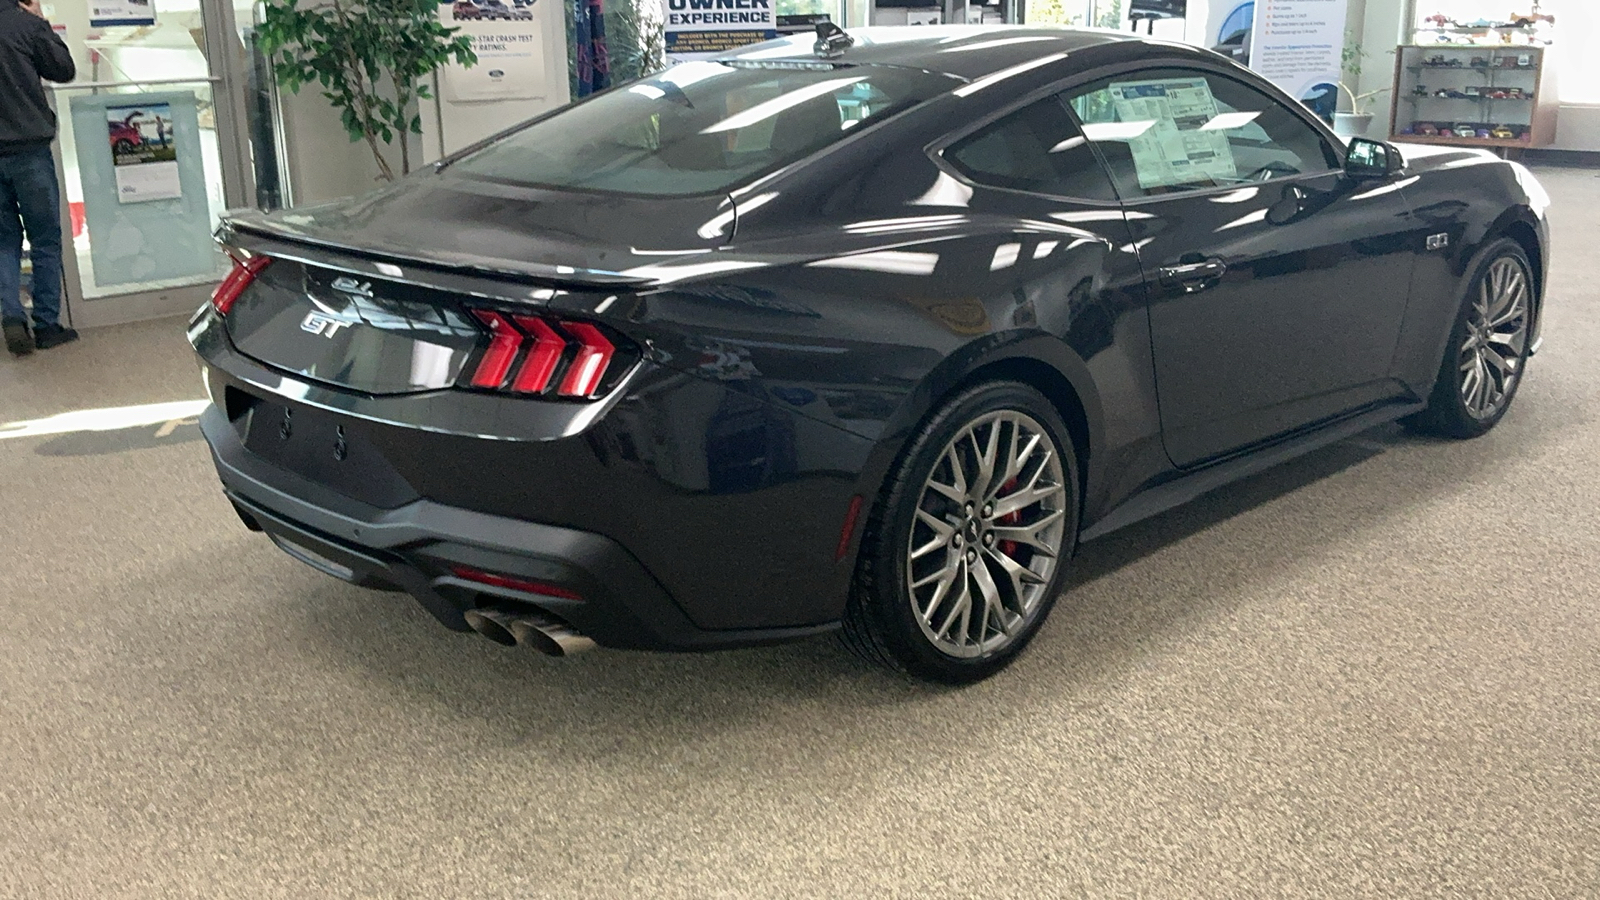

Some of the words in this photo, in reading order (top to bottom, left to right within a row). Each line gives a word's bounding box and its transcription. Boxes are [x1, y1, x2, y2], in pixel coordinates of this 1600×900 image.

[669, 12, 770, 25] EXPERIENCE
[518, 34, 533, 42] TEST
[300, 310, 353, 339] GT
